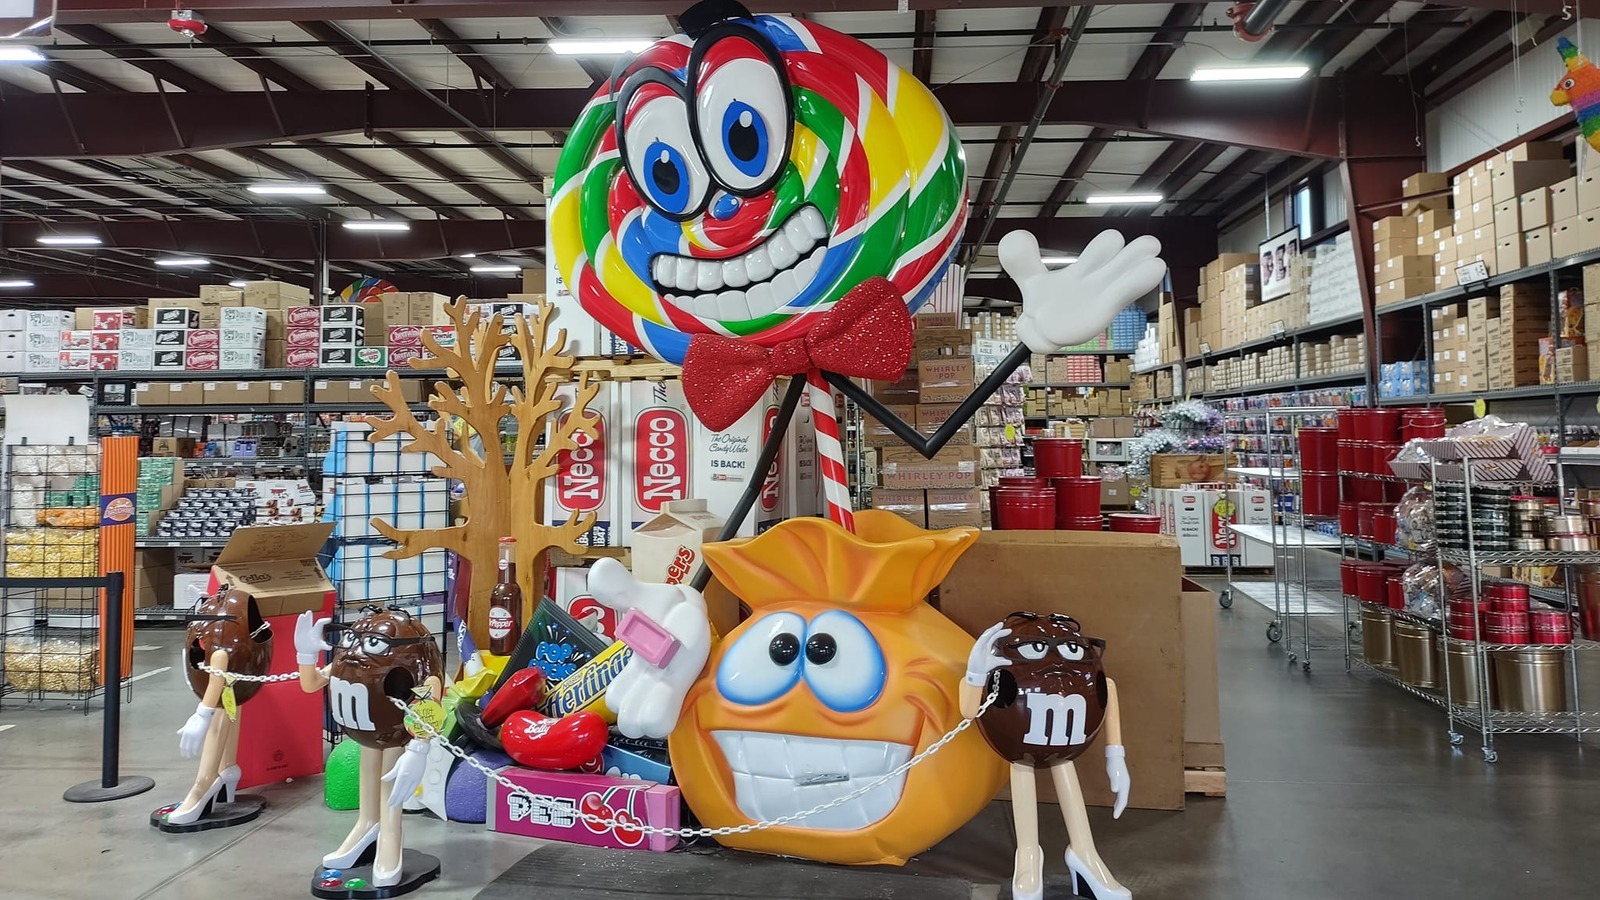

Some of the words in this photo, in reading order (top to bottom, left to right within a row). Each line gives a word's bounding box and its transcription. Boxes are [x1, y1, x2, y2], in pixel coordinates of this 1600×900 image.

[653, 380, 667, 404] The
[708, 443, 729, 454] Candy
[711, 433, 723, 443] The
[721, 433, 749, 445] Original
[563, 429, 599, 499] Necc
[643, 417, 681, 500] Necco
[711, 459, 719, 468] IS
[720, 460, 746, 469] BACK!
[239, 573, 272, 584] Cella's
[536, 641, 573, 663] POP
[330, 675, 377, 732] m
[1023, 692, 1087, 746] m
